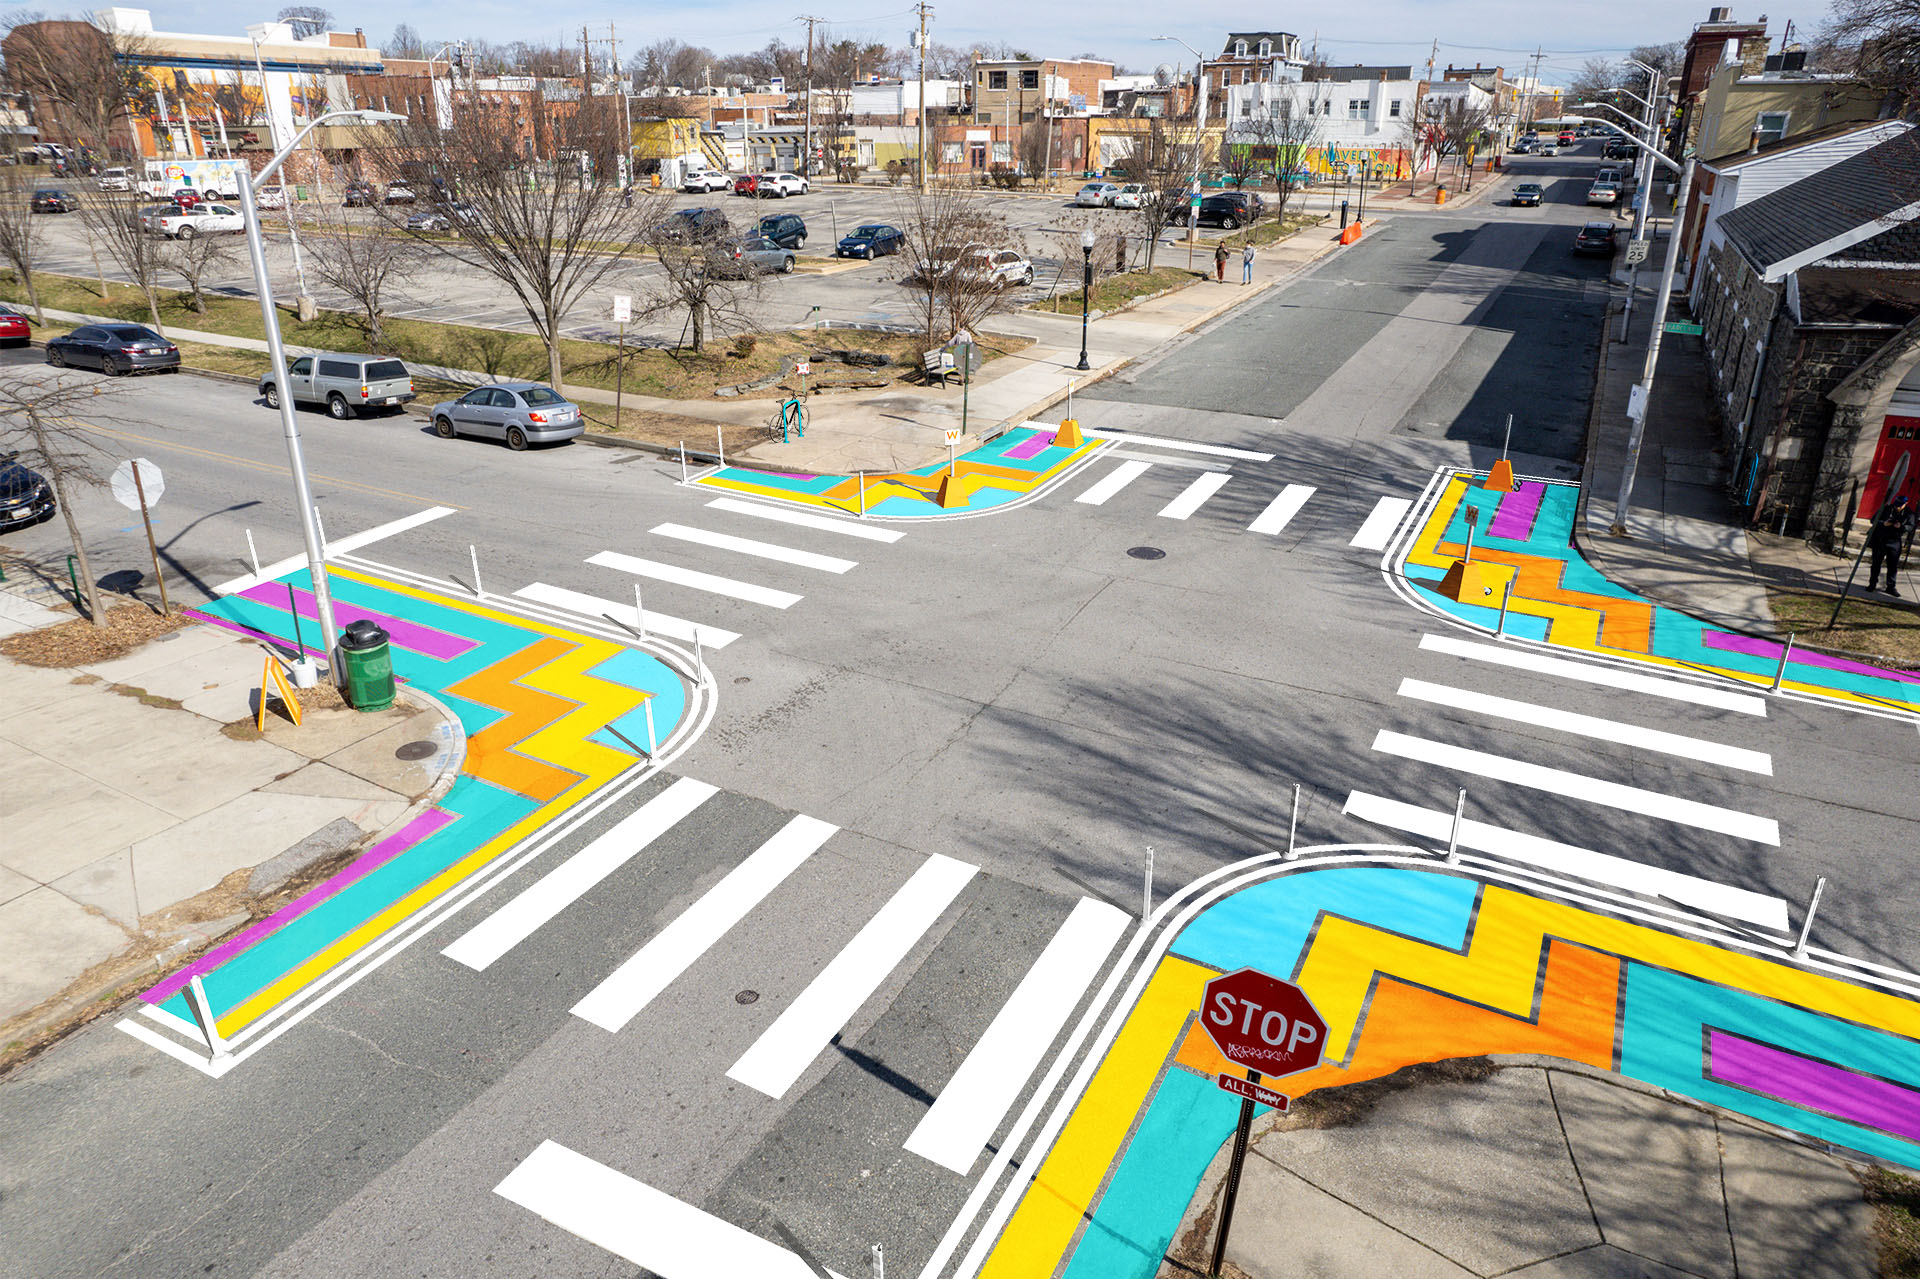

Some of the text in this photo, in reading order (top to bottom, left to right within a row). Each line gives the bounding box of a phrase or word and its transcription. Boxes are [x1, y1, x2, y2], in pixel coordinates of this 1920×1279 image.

[1628, 251, 1644, 261] 25
[946, 431, 958, 440] W
[1210, 992, 1318, 1054] STOP
[1225, 1079, 1249, 1096] ALL
